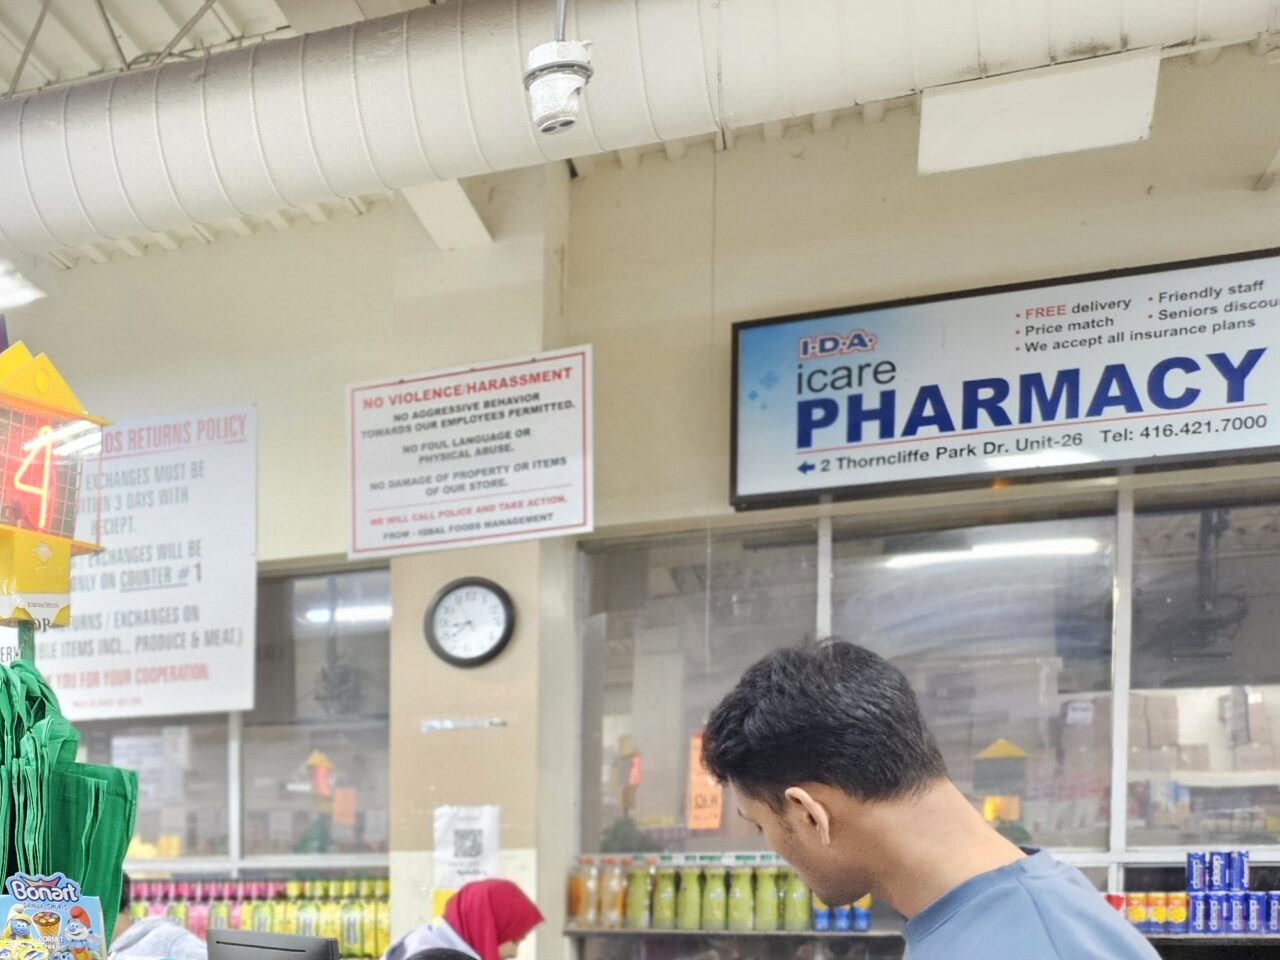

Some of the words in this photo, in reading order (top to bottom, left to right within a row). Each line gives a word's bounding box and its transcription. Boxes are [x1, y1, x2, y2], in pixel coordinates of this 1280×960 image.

[1159, 286, 1222, 303] Friendly
[1228, 280, 1264, 295] staff
[1024, 304, 1067, 320] FREE
[1071, 297, 1132, 316] delivery
[1158, 306, 1218, 321] Seniors
[1224, 299, 1280, 312] discou
[1024, 321, 1059, 337] Price
[1061, 316, 1114, 331] match
[1024, 341, 1048, 353] We
[1053, 334, 1102, 352] accept
[1107, 330, 1124, 345] all
[1129, 324, 1207, 343] insurance
[1212, 317, 1256, 338] plans
[797, 359, 896, 394] icare
[362, 397, 384, 410] NO
[393, 412, 409, 422] NO
[412, 402, 480, 420] AGGRESSIVE
[483, 392, 540, 410] BEHAVIOR
[797, 347, 1268, 449] PHARMACY
[128, 423, 191, 450] RETURNS
[197, 414, 247, 444] POLICY
[361, 425, 412, 439] TOWARDS
[415, 420, 438, 432] OUR
[441, 412, 505, 429] EMPLOYEES
[508, 400, 575, 418] PERMITTED.
[402, 444, 418, 454] NO
[421, 440, 449, 451] FOUL
[452, 431, 511, 448] LANGUAGE
[515, 428, 531, 438] OR
[820, 458, 830, 473] 2
[837, 448, 930, 471] Thorncliffe
[935, 443, 976, 460] Park
[982, 438, 1009, 455] Dr.
[1015, 432, 1084, 452] Unit-26
[1100, 426, 1134, 444] Tel:
[1140, 414, 1268, 439] 416.421.7000
[419, 451, 470, 465] PHYSICAL
[474, 444, 514, 457] ABUSE.
[14, 426, 53, 528] 4
[154, 462, 186, 484] MUST
[190, 460, 205, 478] BE
[370, 480, 385, 491] NO
[388, 474, 432, 489] DAMAGE
[435, 473, 449, 483] OF
[453, 464, 510, 481] PROPERTY
[513, 461, 529, 472] OR
[532, 457, 566, 469] ITEMS
[426, 487, 439, 496] OF
[442, 483, 466, 494] OUR
[470, 478, 508, 491] STORE.
[387, 514, 409, 525] WILL
[412, 510, 434, 522] CALL
[438, 507, 472, 519] POLICE
[476, 503, 496, 514] AND
[499, 499, 524, 511] TAKE
[12, 879, 79, 901] Bonart
